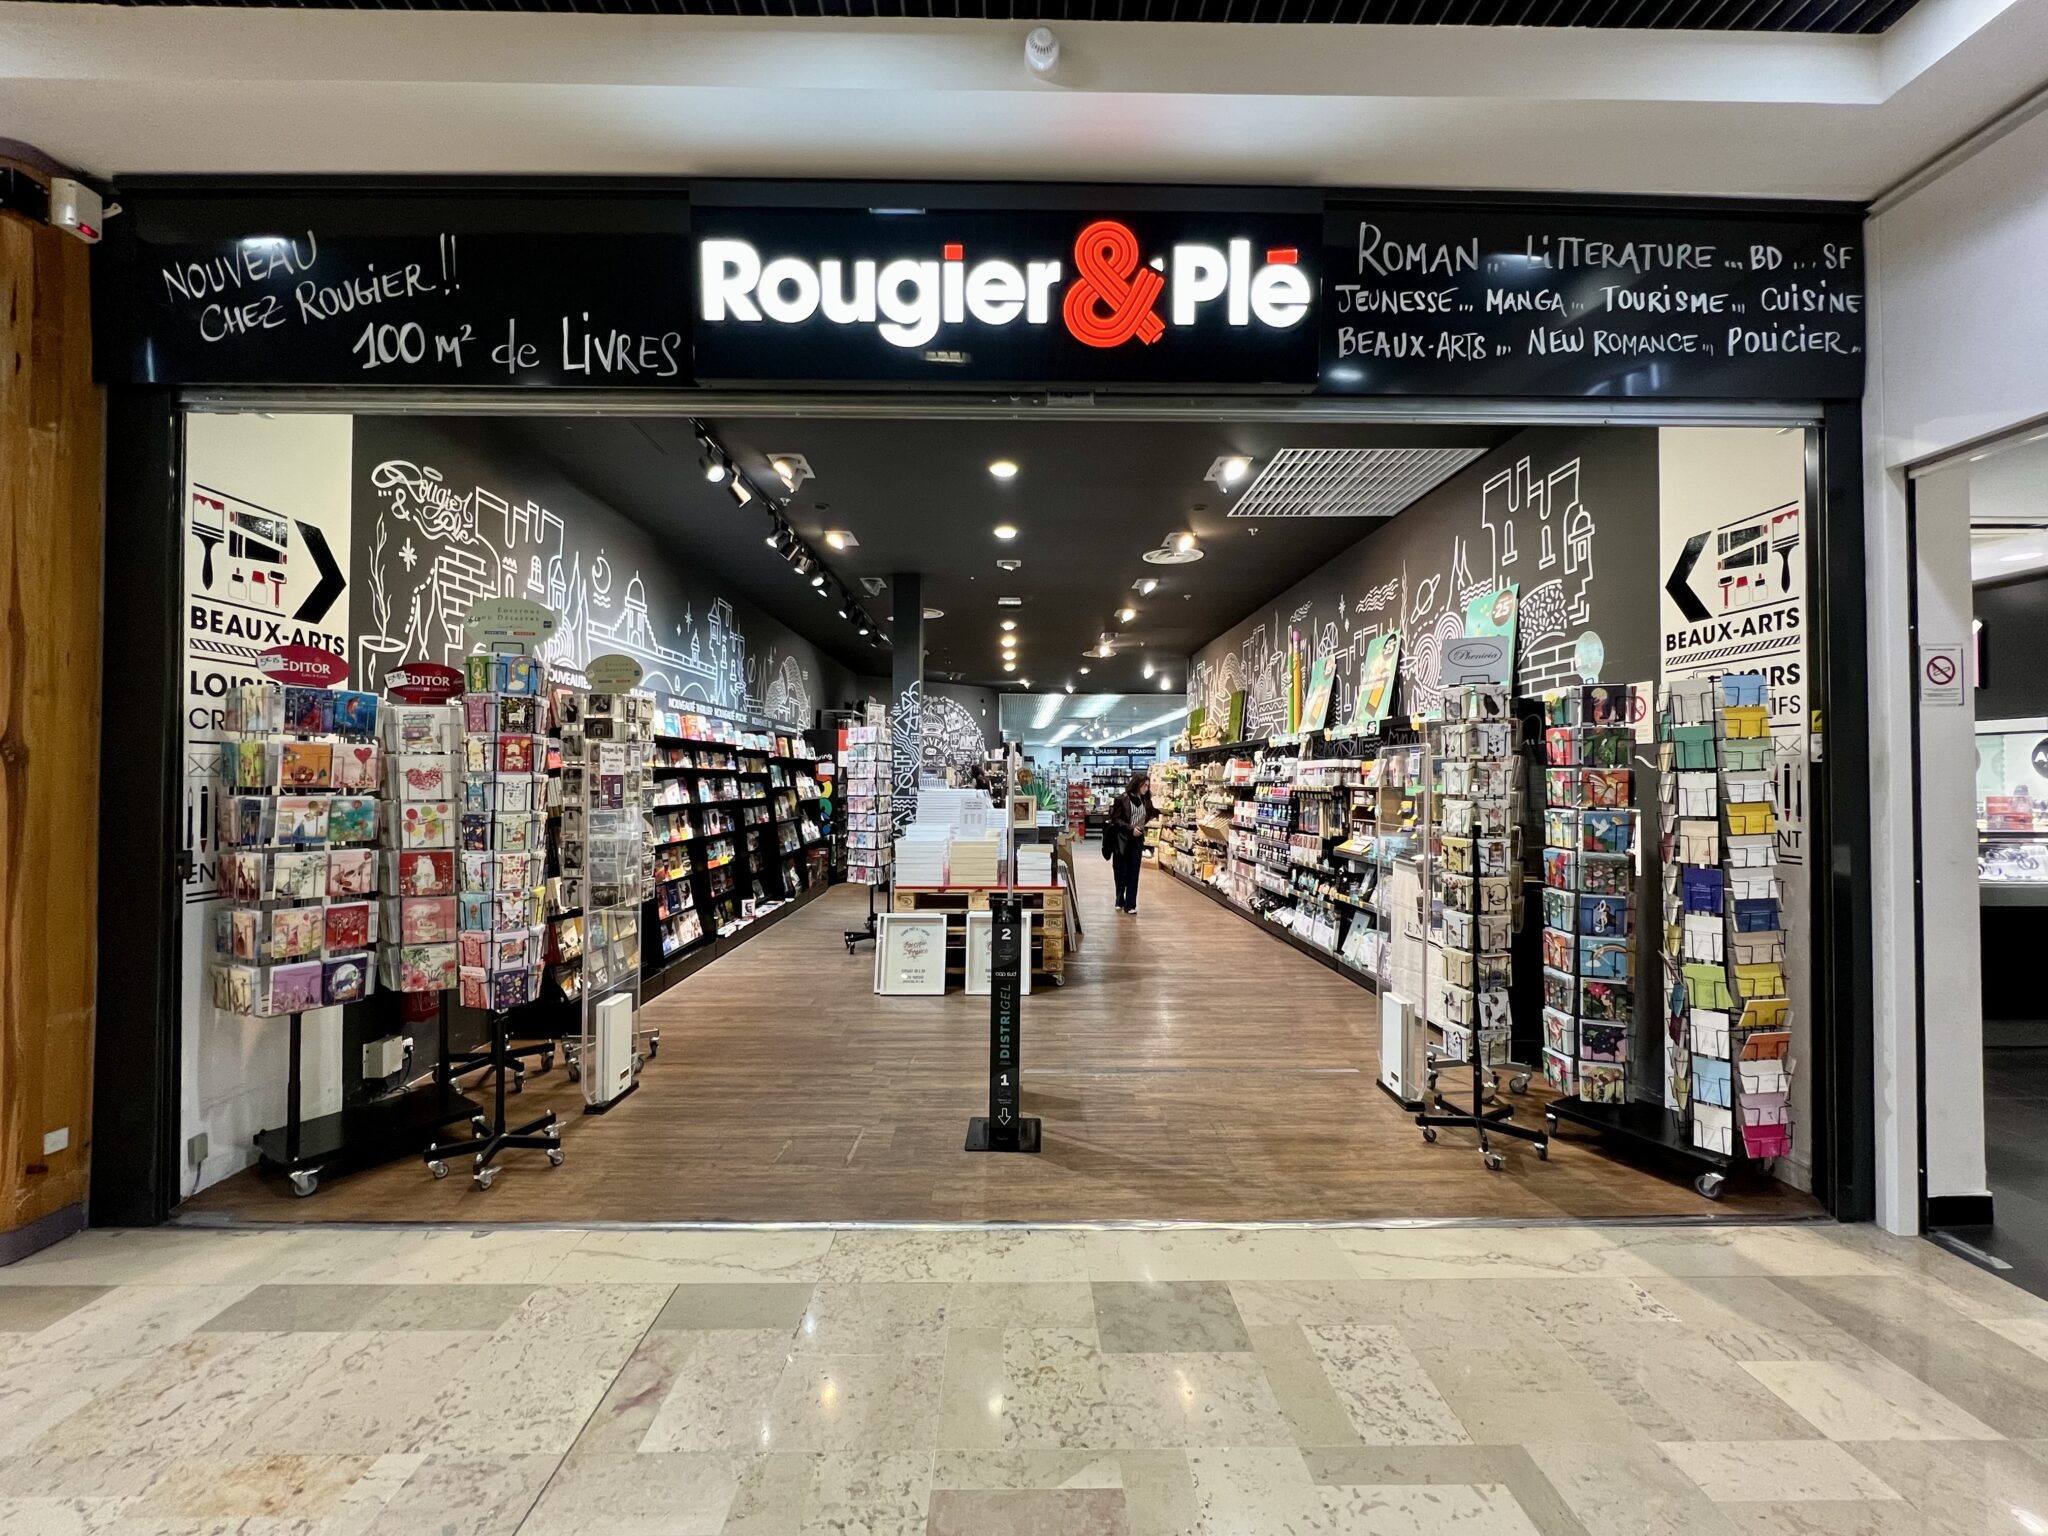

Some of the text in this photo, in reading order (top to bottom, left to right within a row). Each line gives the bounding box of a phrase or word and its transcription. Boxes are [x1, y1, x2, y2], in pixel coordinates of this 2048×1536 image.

[162, 230, 317, 303] NOUVEAU
[1358, 221, 1478, 277] ROMAN
[1823, 243, 1854, 270] SF
[700, 238, 1061, 348] Rougier
[200, 295, 286, 342] CHEZ
[1528, 326, 1585, 355] NEW
[352, 322, 425, 369] 100
[490, 318, 540, 374] de
[190, 605, 345, 656] BEAUX-ARTS
[1665, 606, 1800, 652] BEAUX-ARTS
[281, 658, 331, 675] EDITOR
[404, 672, 450, 688] EDITOR
[1001, 928, 1012, 940] 2
[1000, 984, 1011, 1059] DISTRIGEL
[1000, 1074, 1010, 1086] 1
